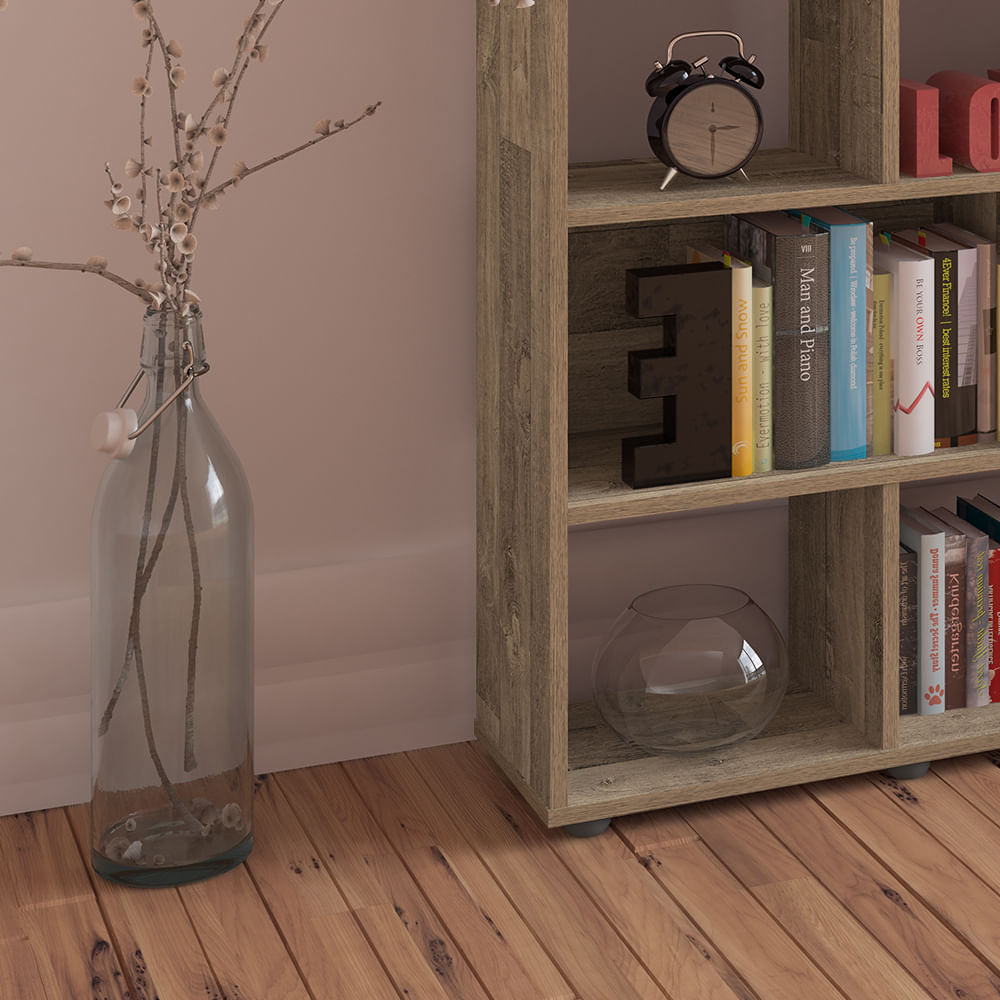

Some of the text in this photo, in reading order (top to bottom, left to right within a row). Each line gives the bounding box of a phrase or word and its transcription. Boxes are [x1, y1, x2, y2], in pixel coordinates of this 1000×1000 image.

[800, 245, 812, 253] VIII
[916, 278, 924, 288] BE
[916, 290, 924, 315] YOUR
[736, 298, 748, 403] Sun and Snow
[800, 268, 815, 382] Man and Piano
[916, 316, 924, 342] OWN
[942, 257, 952, 399] 4Ever Finance! best interest rates
[755, 302, 770, 449] Evermotion with love
